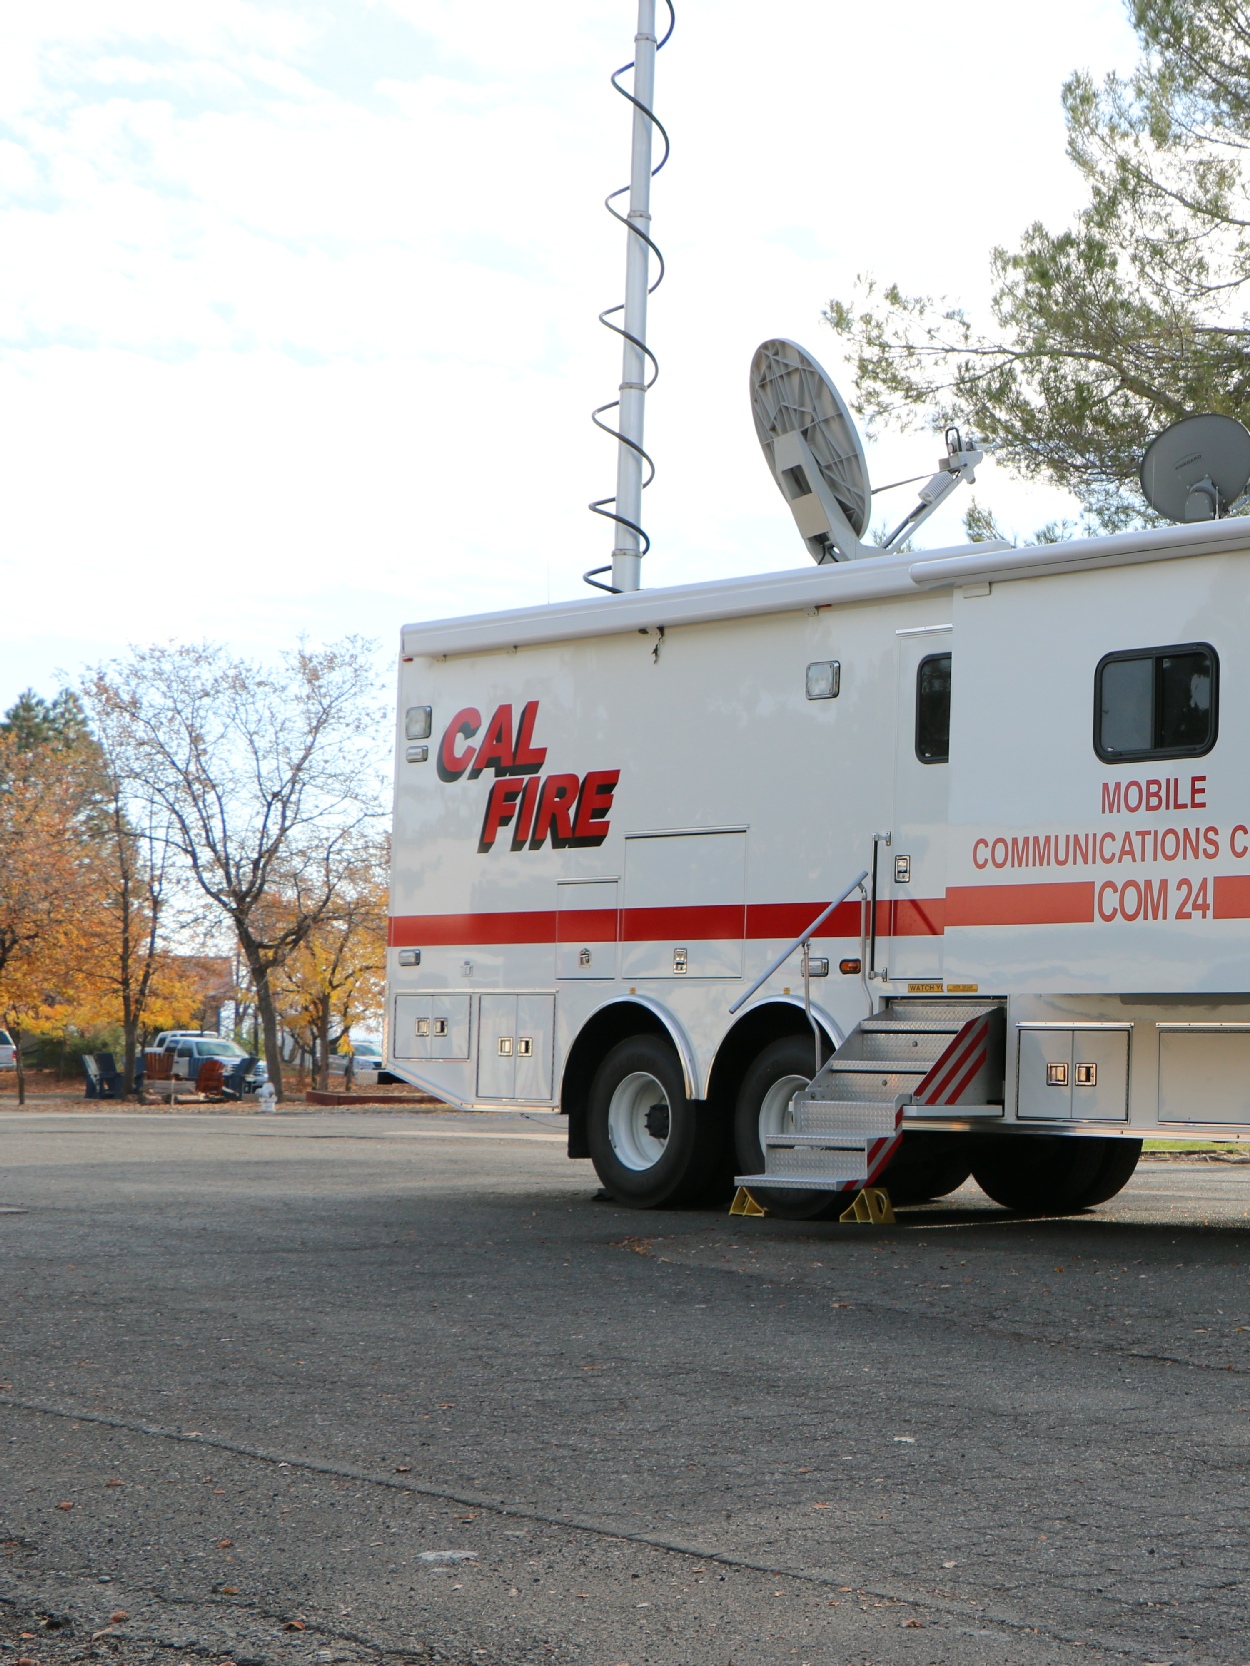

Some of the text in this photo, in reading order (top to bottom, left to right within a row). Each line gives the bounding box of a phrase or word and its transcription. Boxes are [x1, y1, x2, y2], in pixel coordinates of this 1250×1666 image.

[436, 700, 548, 784] CAL
[476, 768, 621, 854] FIRE
[1101, 775, 1207, 814] MOBILE
[972, 825, 1220, 870] COMMUNICATIONS
[1097, 877, 1211, 923] COM 24
[909, 984, 934, 992] WATCH
